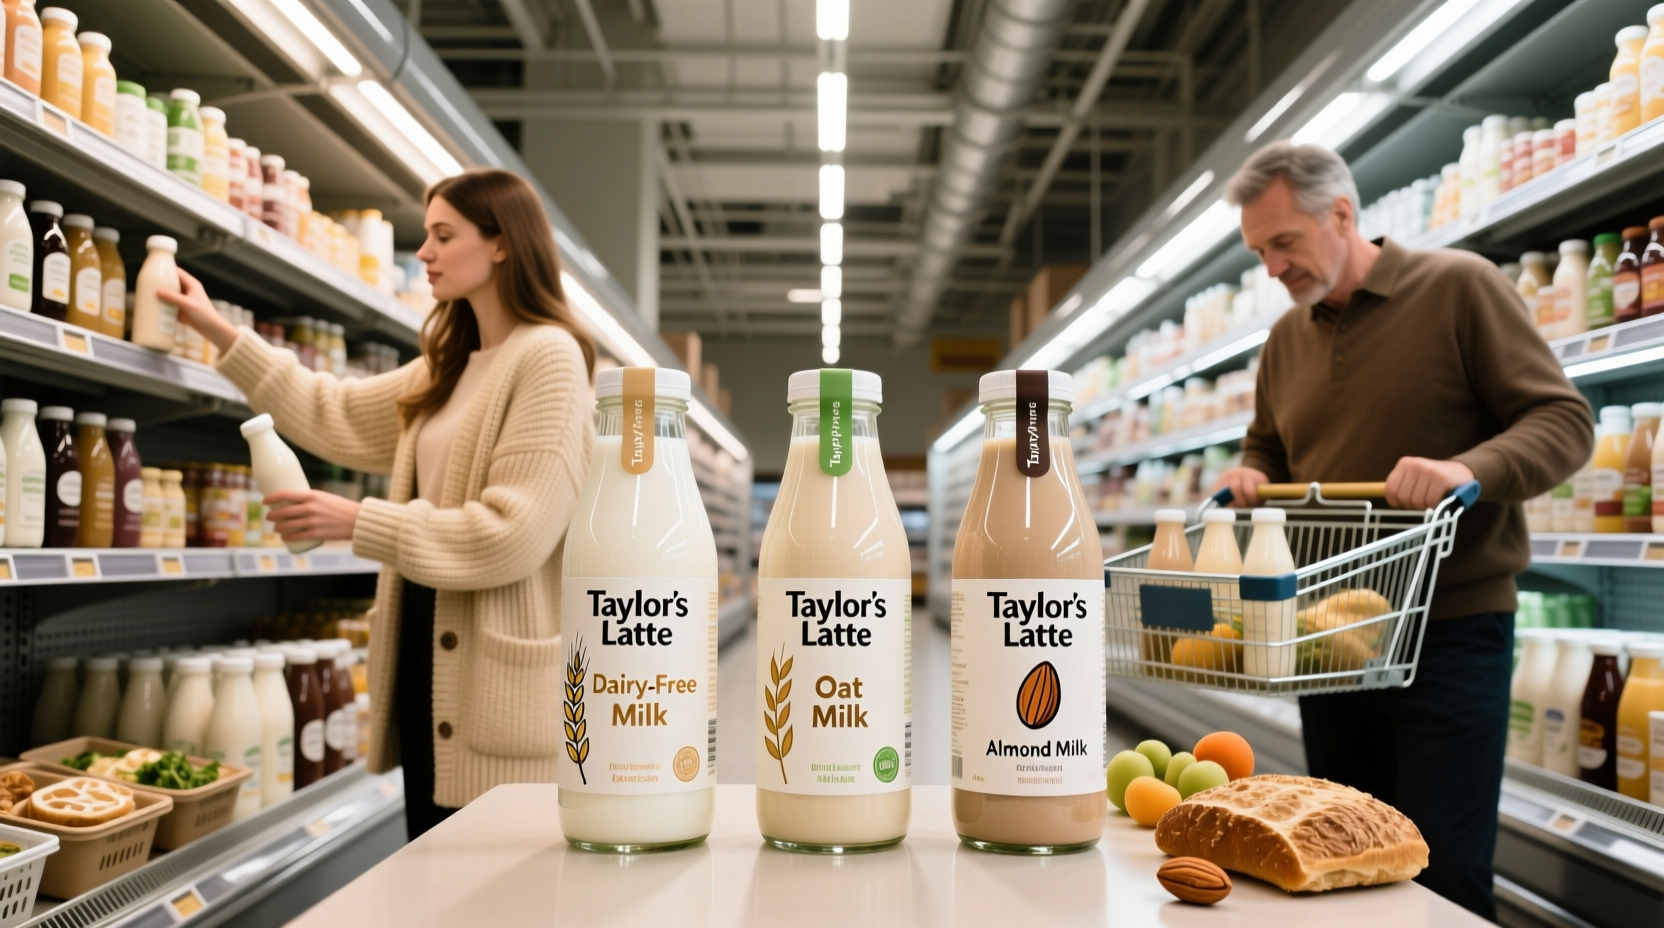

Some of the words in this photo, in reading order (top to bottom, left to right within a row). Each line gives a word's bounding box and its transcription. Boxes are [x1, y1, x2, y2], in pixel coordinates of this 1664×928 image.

[587, 589, 689, 625] Taylor's
[785, 589, 887, 625] Taylor's
[986, 591, 1087, 626] Taylor's
[601, 620, 673, 647] Latte
[801, 620, 872, 647] Latte
[1003, 621, 1073, 648] Latte
[592, 672, 697, 700] Dairy-Free
[814, 674, 863, 699] Oat
[611, 702, 668, 727] Milk
[812, 703, 869, 728] Milk
[985, 739, 1052, 758] Almond
[1055, 738, 1088, 757] Milk
